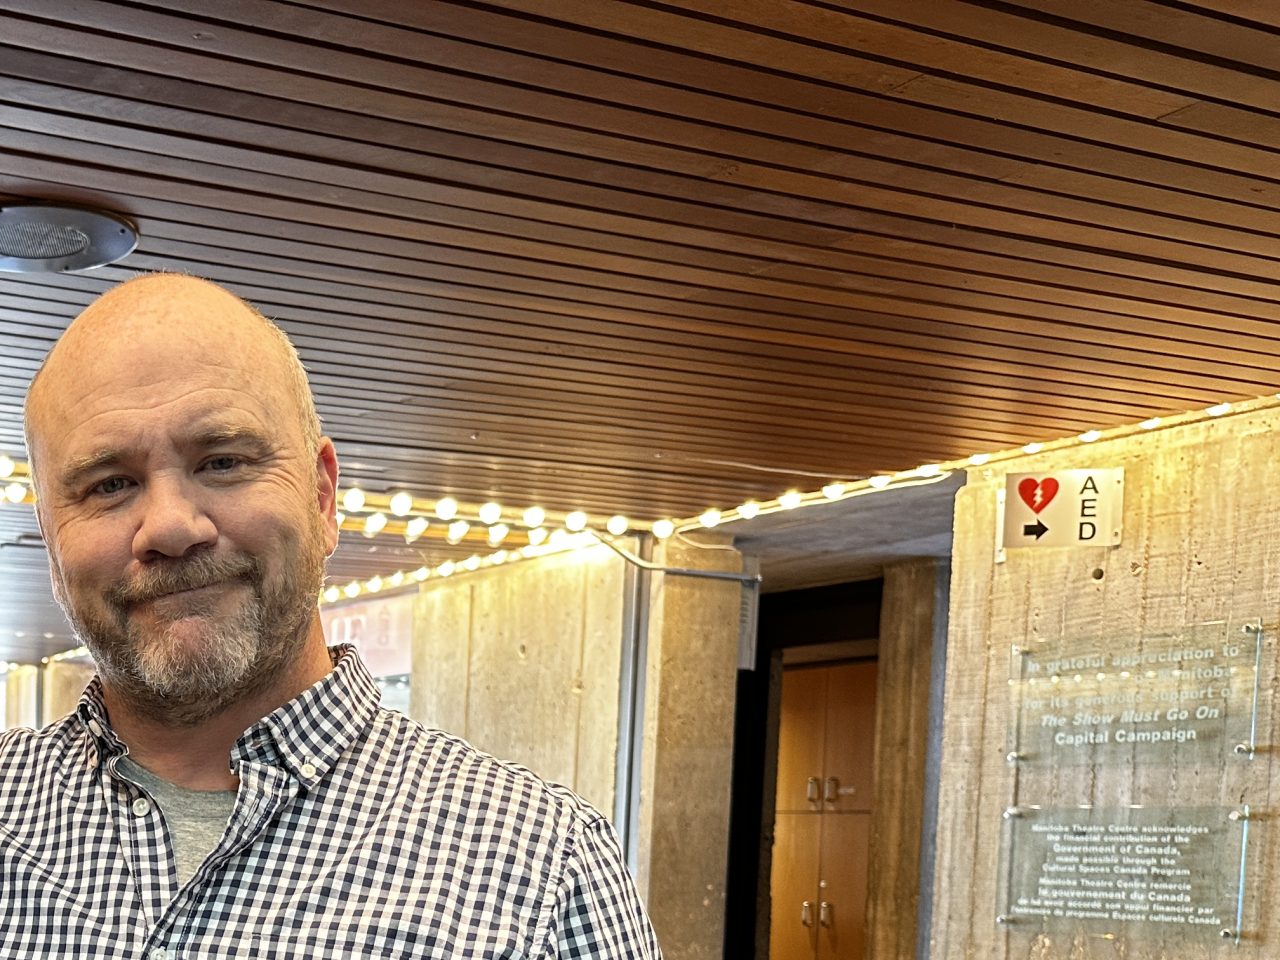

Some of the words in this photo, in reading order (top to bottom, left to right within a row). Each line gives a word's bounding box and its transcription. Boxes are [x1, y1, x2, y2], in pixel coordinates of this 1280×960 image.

[1079, 476, 1099, 540] AED
[1027, 661, 1040, 672] In
[1047, 655, 1105, 674] grateful
[1112, 649, 1214, 668] appreciation
[1223, 645, 1239, 657] to
[1158, 665, 1233, 683] Mnitoba
[1050, 696, 1068, 709] its
[1076, 692, 1143, 709] generous
[1152, 686, 1214, 704] support
[1041, 715, 1067, 727] The
[1072, 712, 1114, 726] Show
[1120, 709, 1160, 723] Must
[1166, 708, 1189, 721] Go
[1196, 706, 1220, 719] On
[1054, 731, 1109, 747] Capital
[1115, 727, 1197, 746] Campaign
[1108, 824, 1138, 832] Centre
[1141, 825, 1209, 834] acknowledges
[1103, 834, 1158, 843] contribution
[1161, 835, 1171, 843] of
[1174, 835, 1190, 843] the
[1053, 843, 1115, 853] Government
[1119, 845, 1131, 853] of
[1135, 845, 1181, 856] Canada,
[1122, 856, 1157, 866] through
[1160, 857, 1176, 865] the
[1113, 865, 1148, 875] Canada
[1151, 867, 1190, 876] Program
[1150, 882, 1192, 891] remercie
[1051, 888, 1126, 900] gouvernement
[1129, 891, 1144, 901] du
[1148, 892, 1191, 902] Canada
[1153, 903, 1194, 913] financier
[1198, 906, 1214, 915] par
[1188, 915, 1221, 925] Canada
